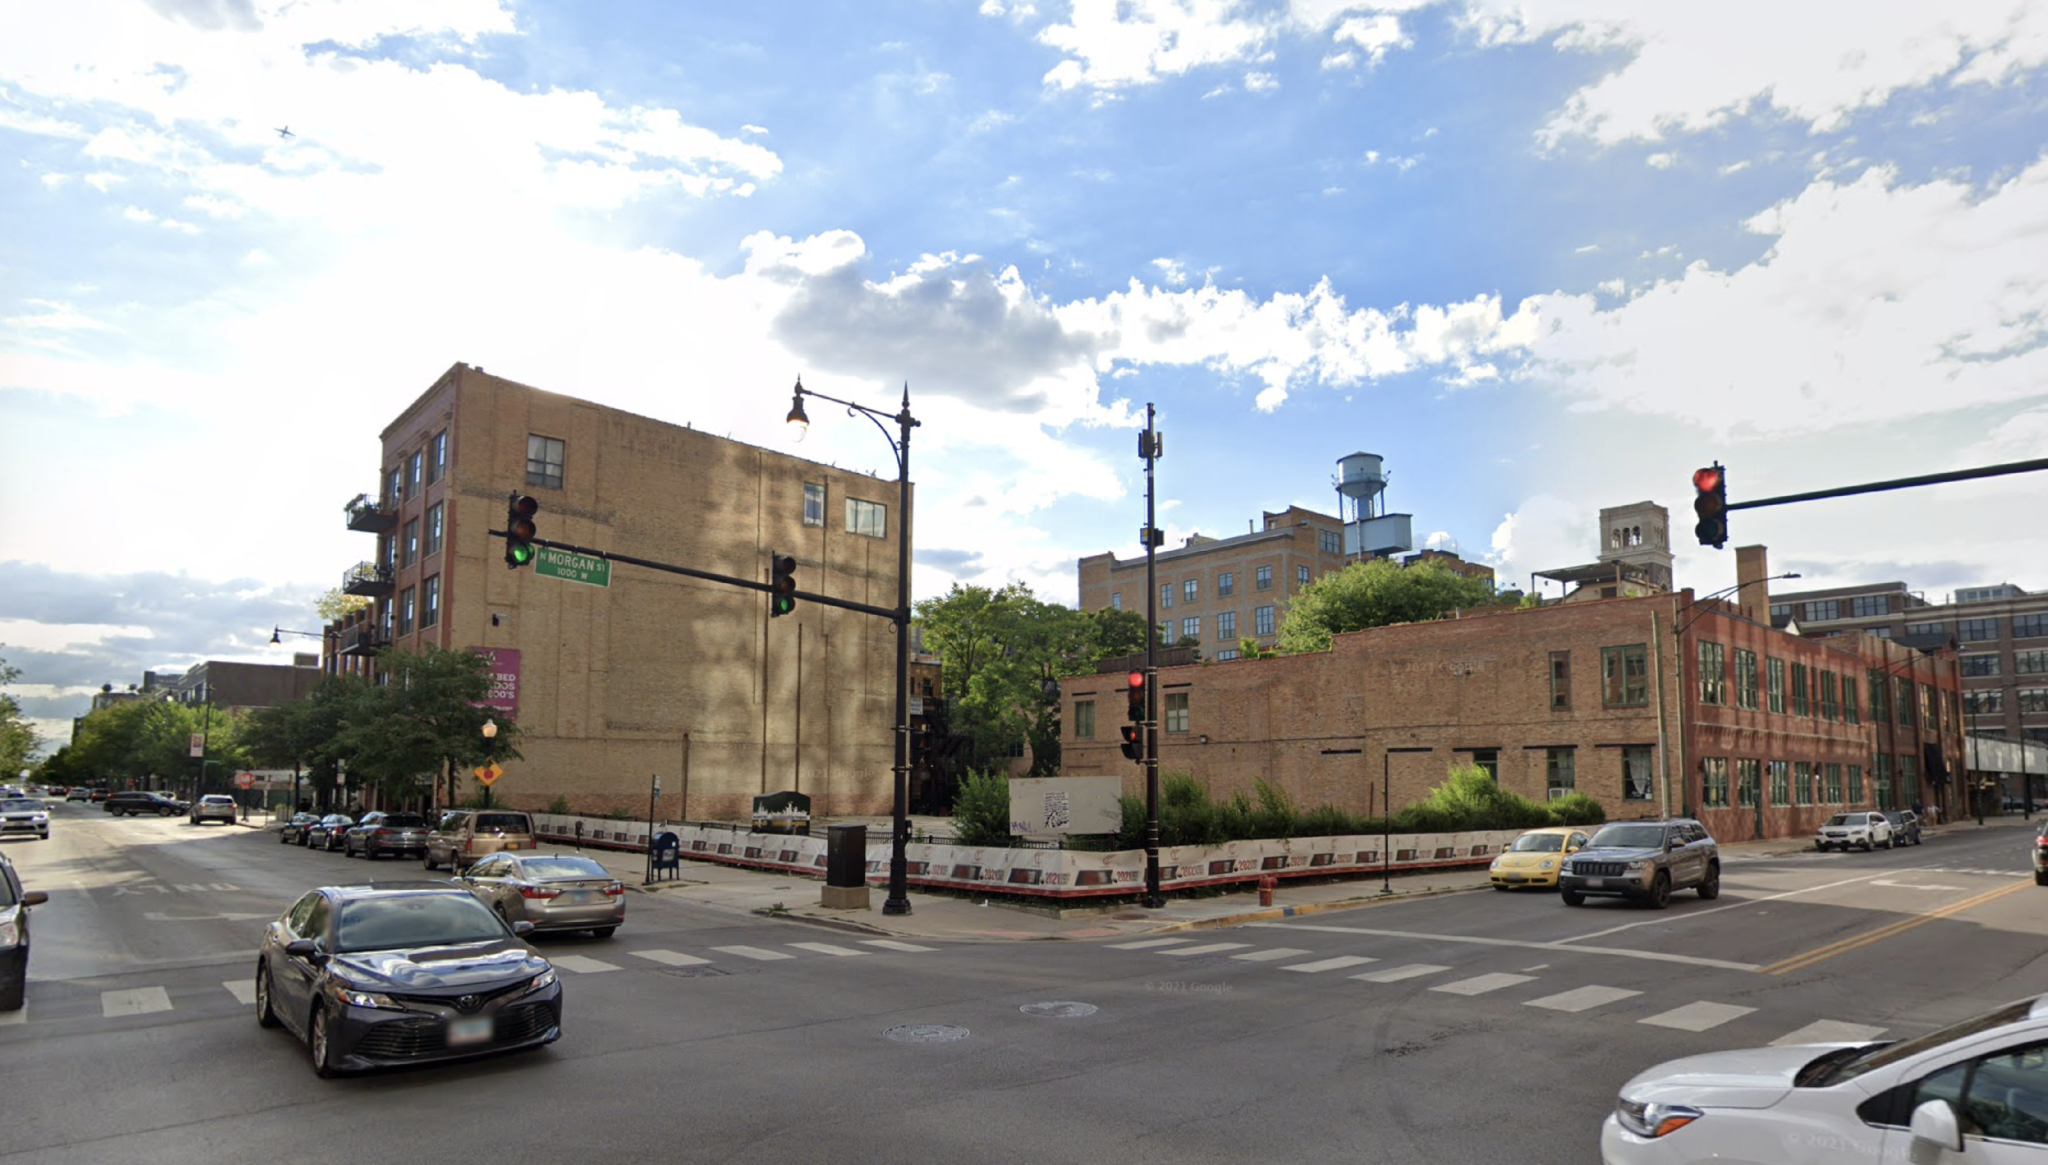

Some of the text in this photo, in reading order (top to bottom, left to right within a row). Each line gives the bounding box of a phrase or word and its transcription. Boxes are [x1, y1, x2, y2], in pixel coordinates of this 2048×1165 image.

[540, 552, 606, 572] N MORGAN ST
[557, 567, 588, 580] 1000 W
[496, 673, 516, 682] BED
[984, 868, 998, 880] 2021
[1117, 871, 1132, 882] 2021
[1181, 866, 1196, 877] 2021
[1046, 872, 1060, 885] 2021
[112, 882, 241, 896] ONLY
